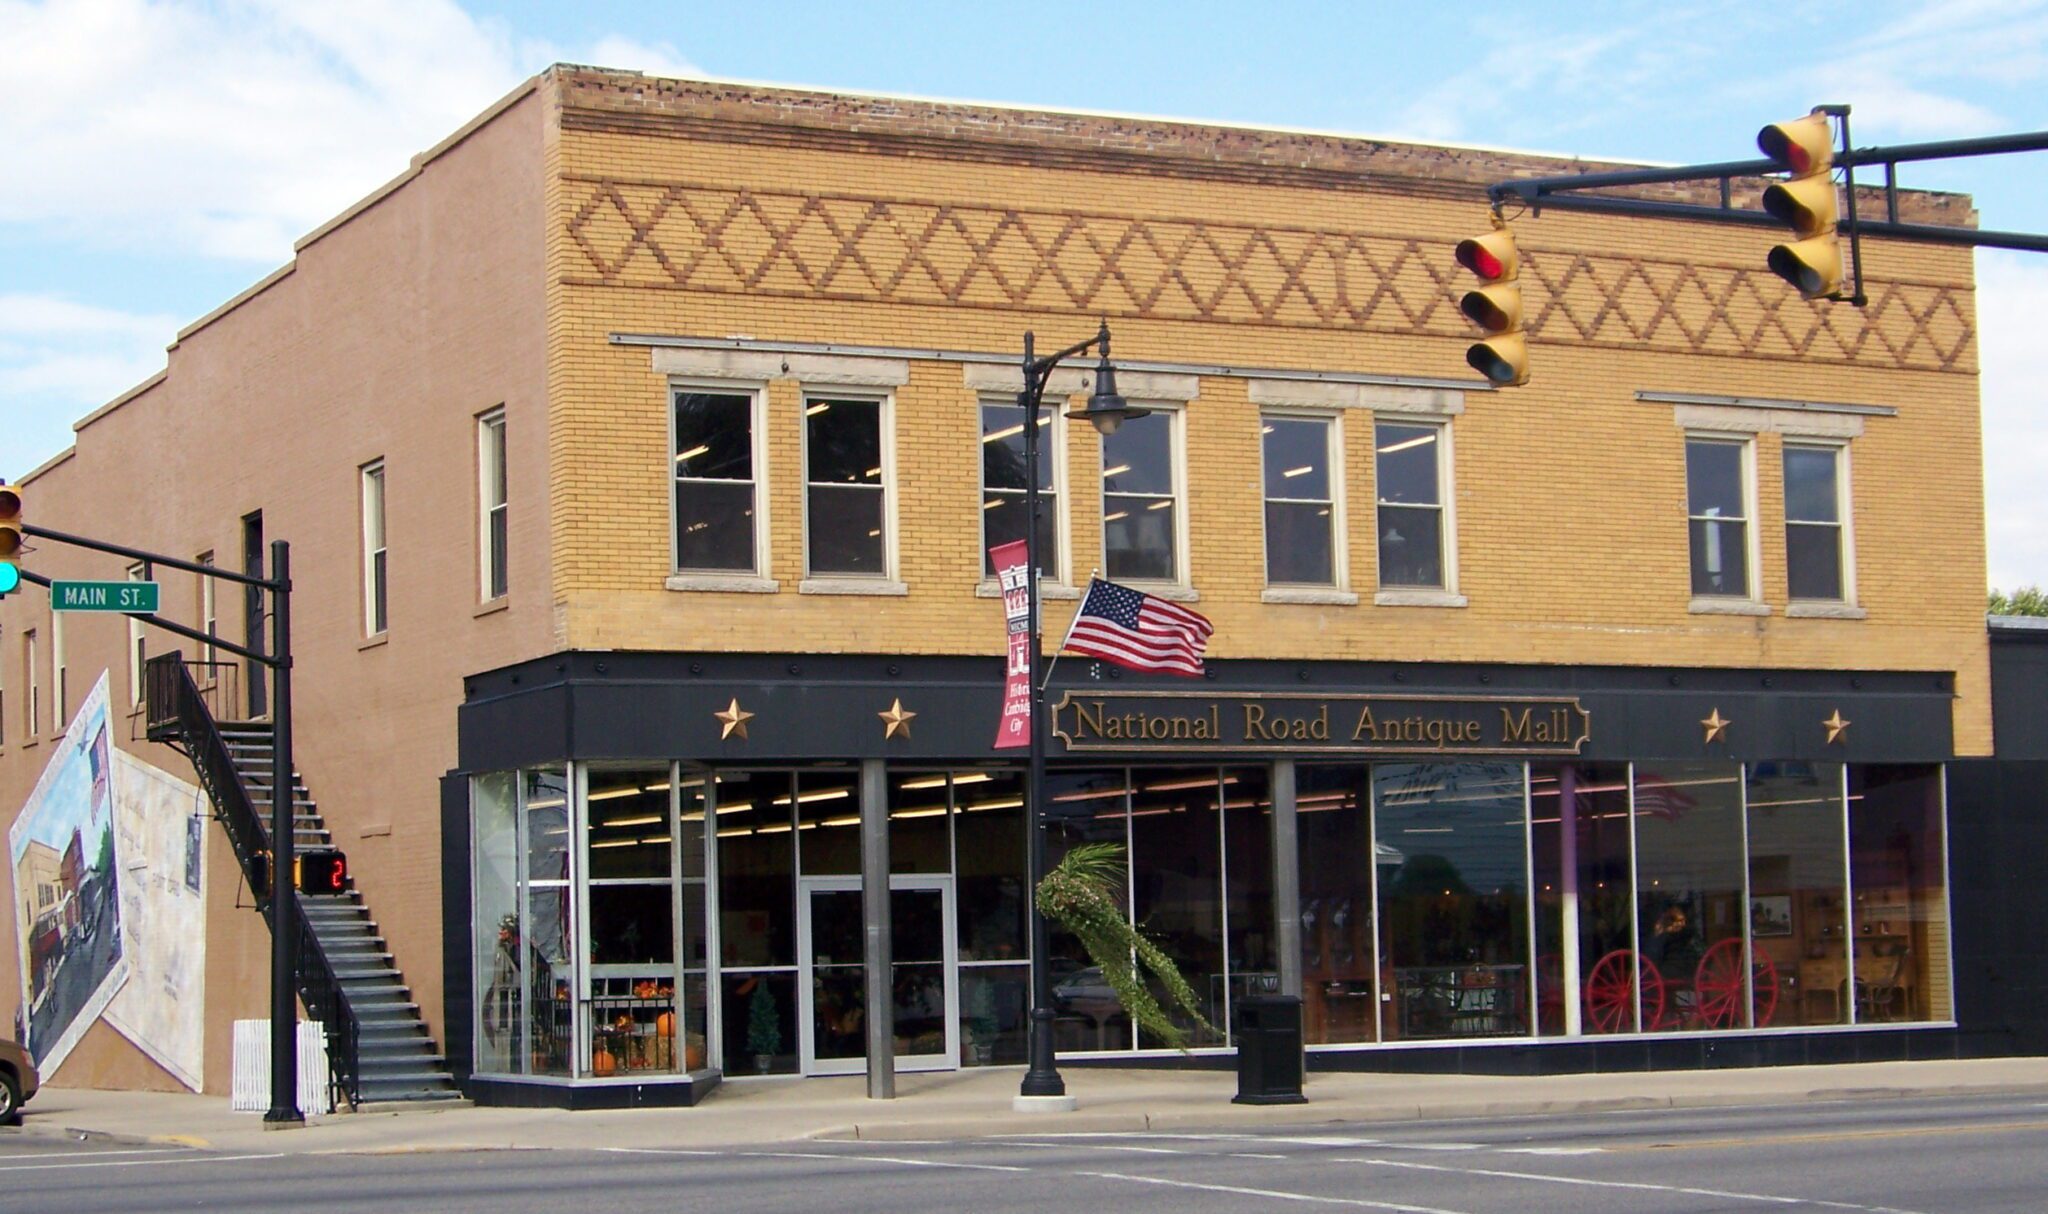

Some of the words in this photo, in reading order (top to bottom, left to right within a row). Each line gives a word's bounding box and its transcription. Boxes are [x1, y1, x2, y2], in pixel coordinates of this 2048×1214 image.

[64, 587, 106, 605] MAIN
[120, 588, 146, 606] ST.
[1072, 701, 1221, 740] National
[1243, 703, 1330, 740] Road
[1351, 705, 1481, 750] Antique
[1500, 707, 1570, 742] Mall
[332, 860, 343, 887] 2
